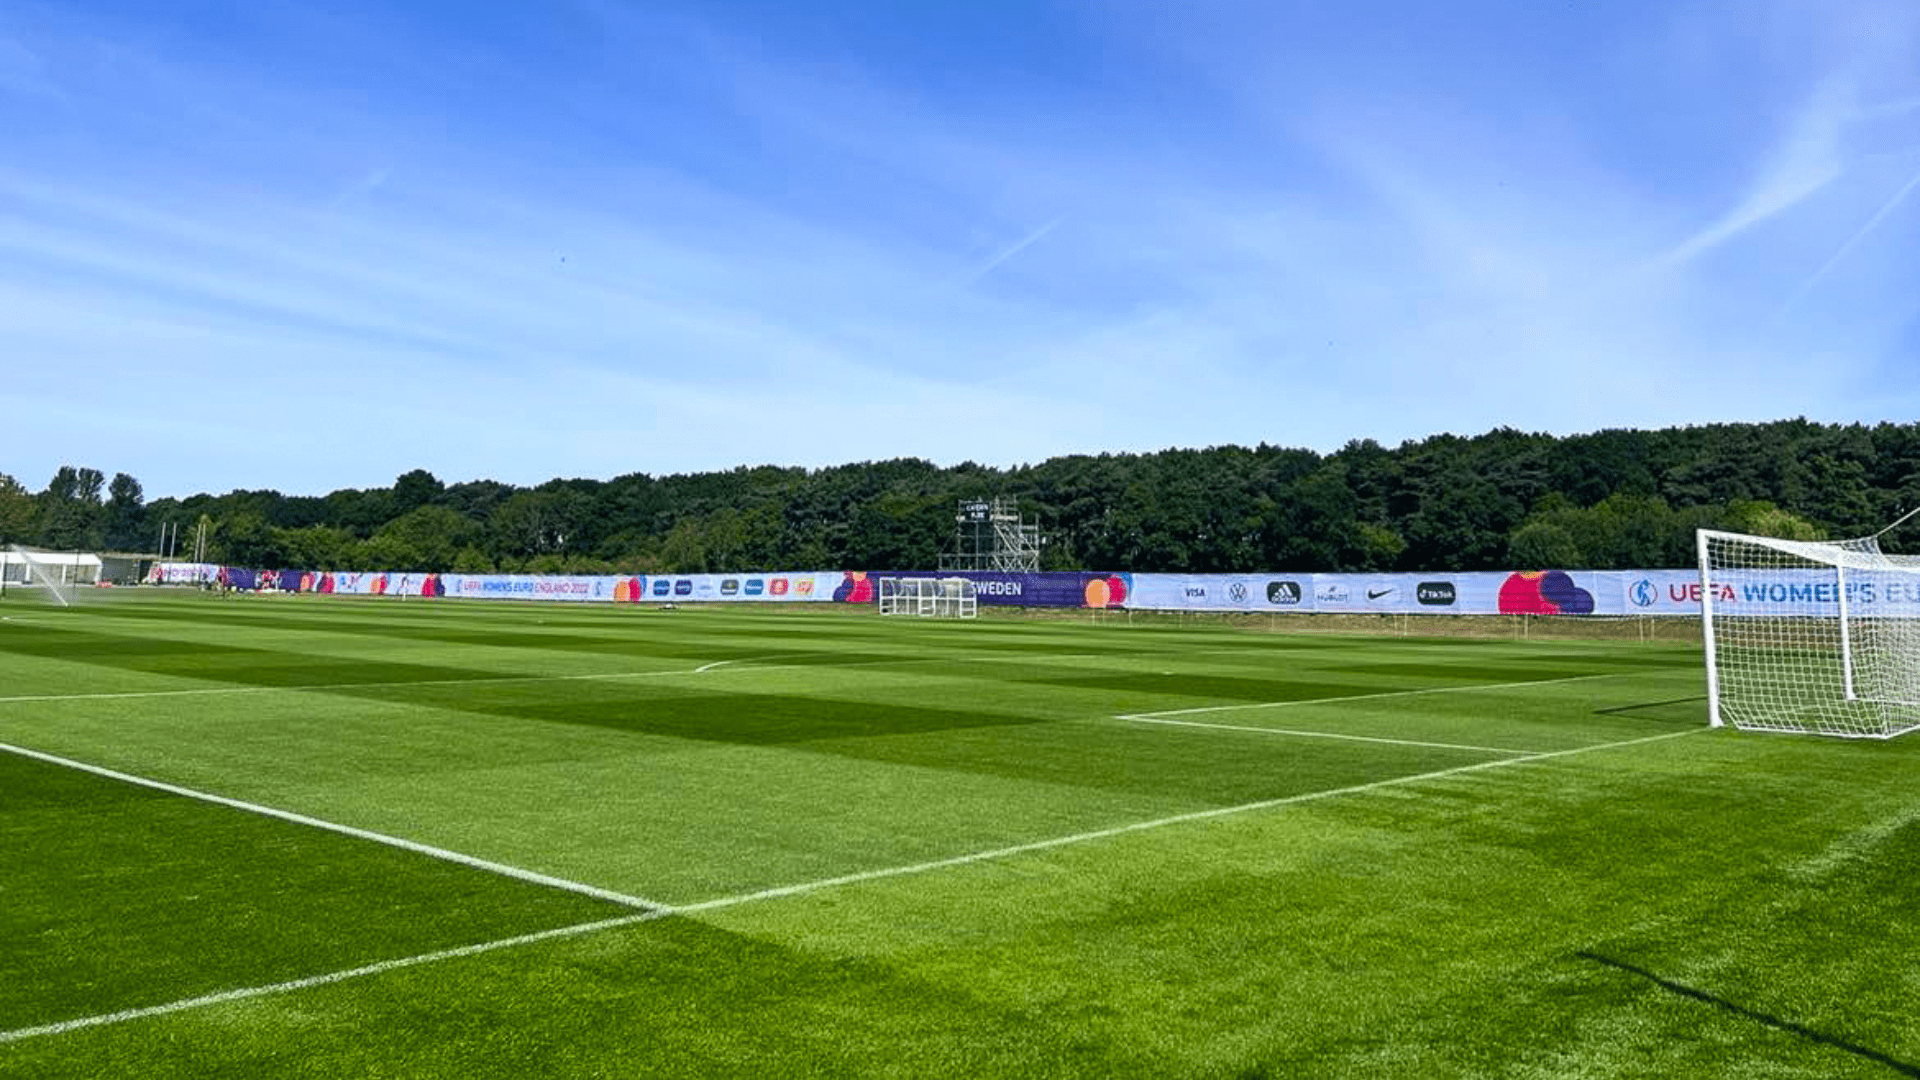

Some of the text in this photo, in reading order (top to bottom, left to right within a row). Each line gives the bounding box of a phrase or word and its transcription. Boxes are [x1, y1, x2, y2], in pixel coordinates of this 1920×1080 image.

[971, 580, 1022, 596] SWEDEN
[1185, 587, 1206, 597] VISA
[1669, 583, 1736, 602] UEFA
